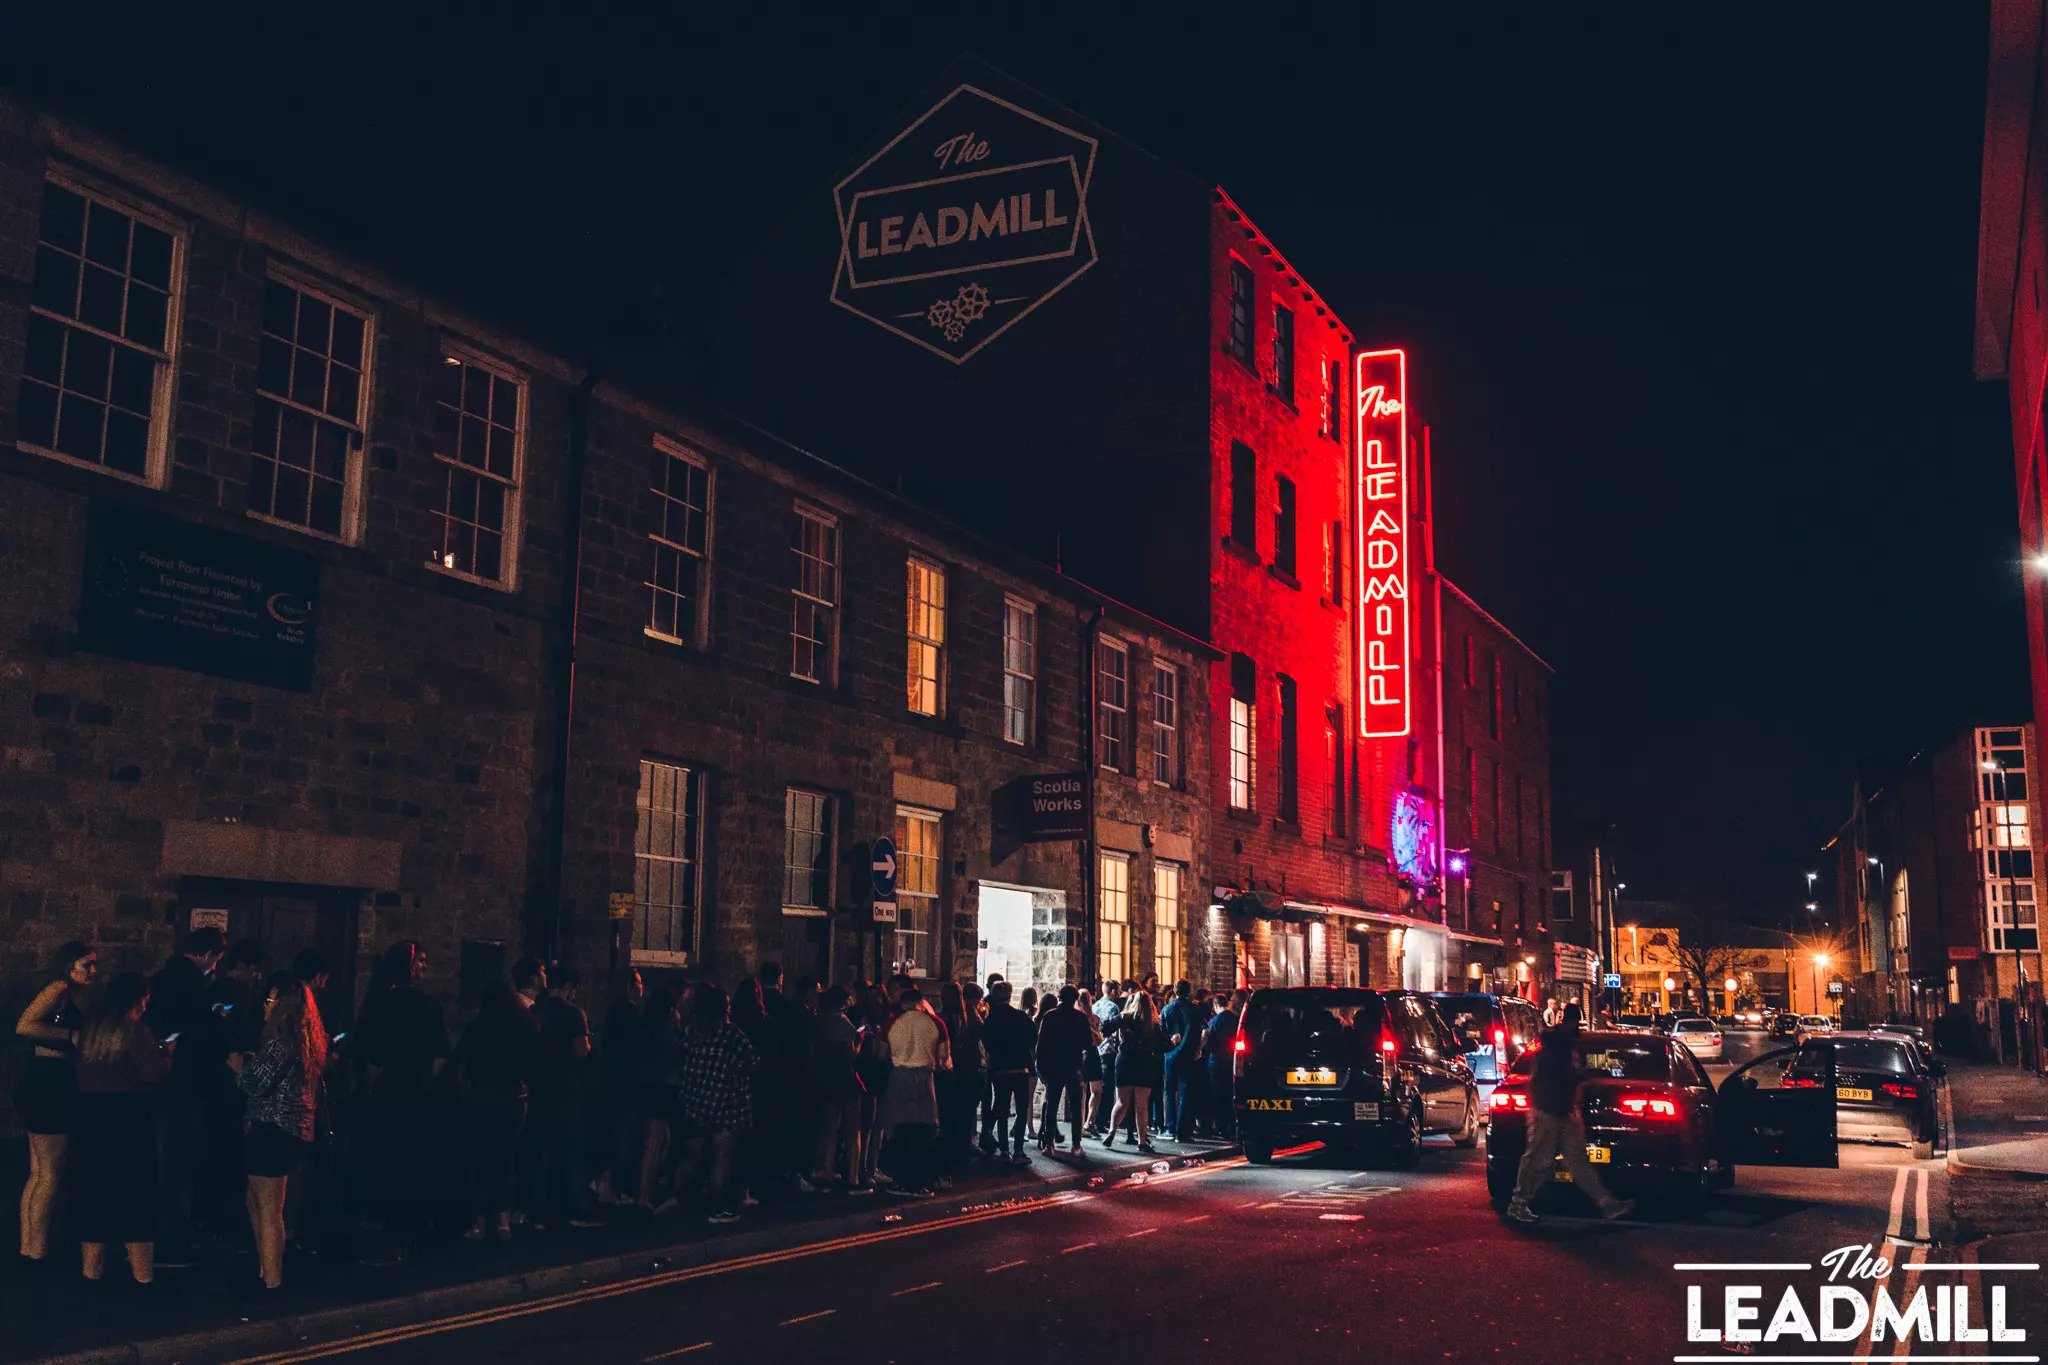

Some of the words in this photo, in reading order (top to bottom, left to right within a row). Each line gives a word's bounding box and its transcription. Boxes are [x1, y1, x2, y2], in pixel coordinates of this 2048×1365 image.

[933, 132, 991, 170] The
[858, 188, 1068, 259] LEADMILL
[1360, 385, 1401, 418] The
[1364, 439, 1405, 705] LEADMILL
[1032, 780, 1081, 794] Scotia
[1032, 798, 1082, 812] Works
[874, 905, 885, 917] One
[1247, 1099, 1293, 1111] TAXI
